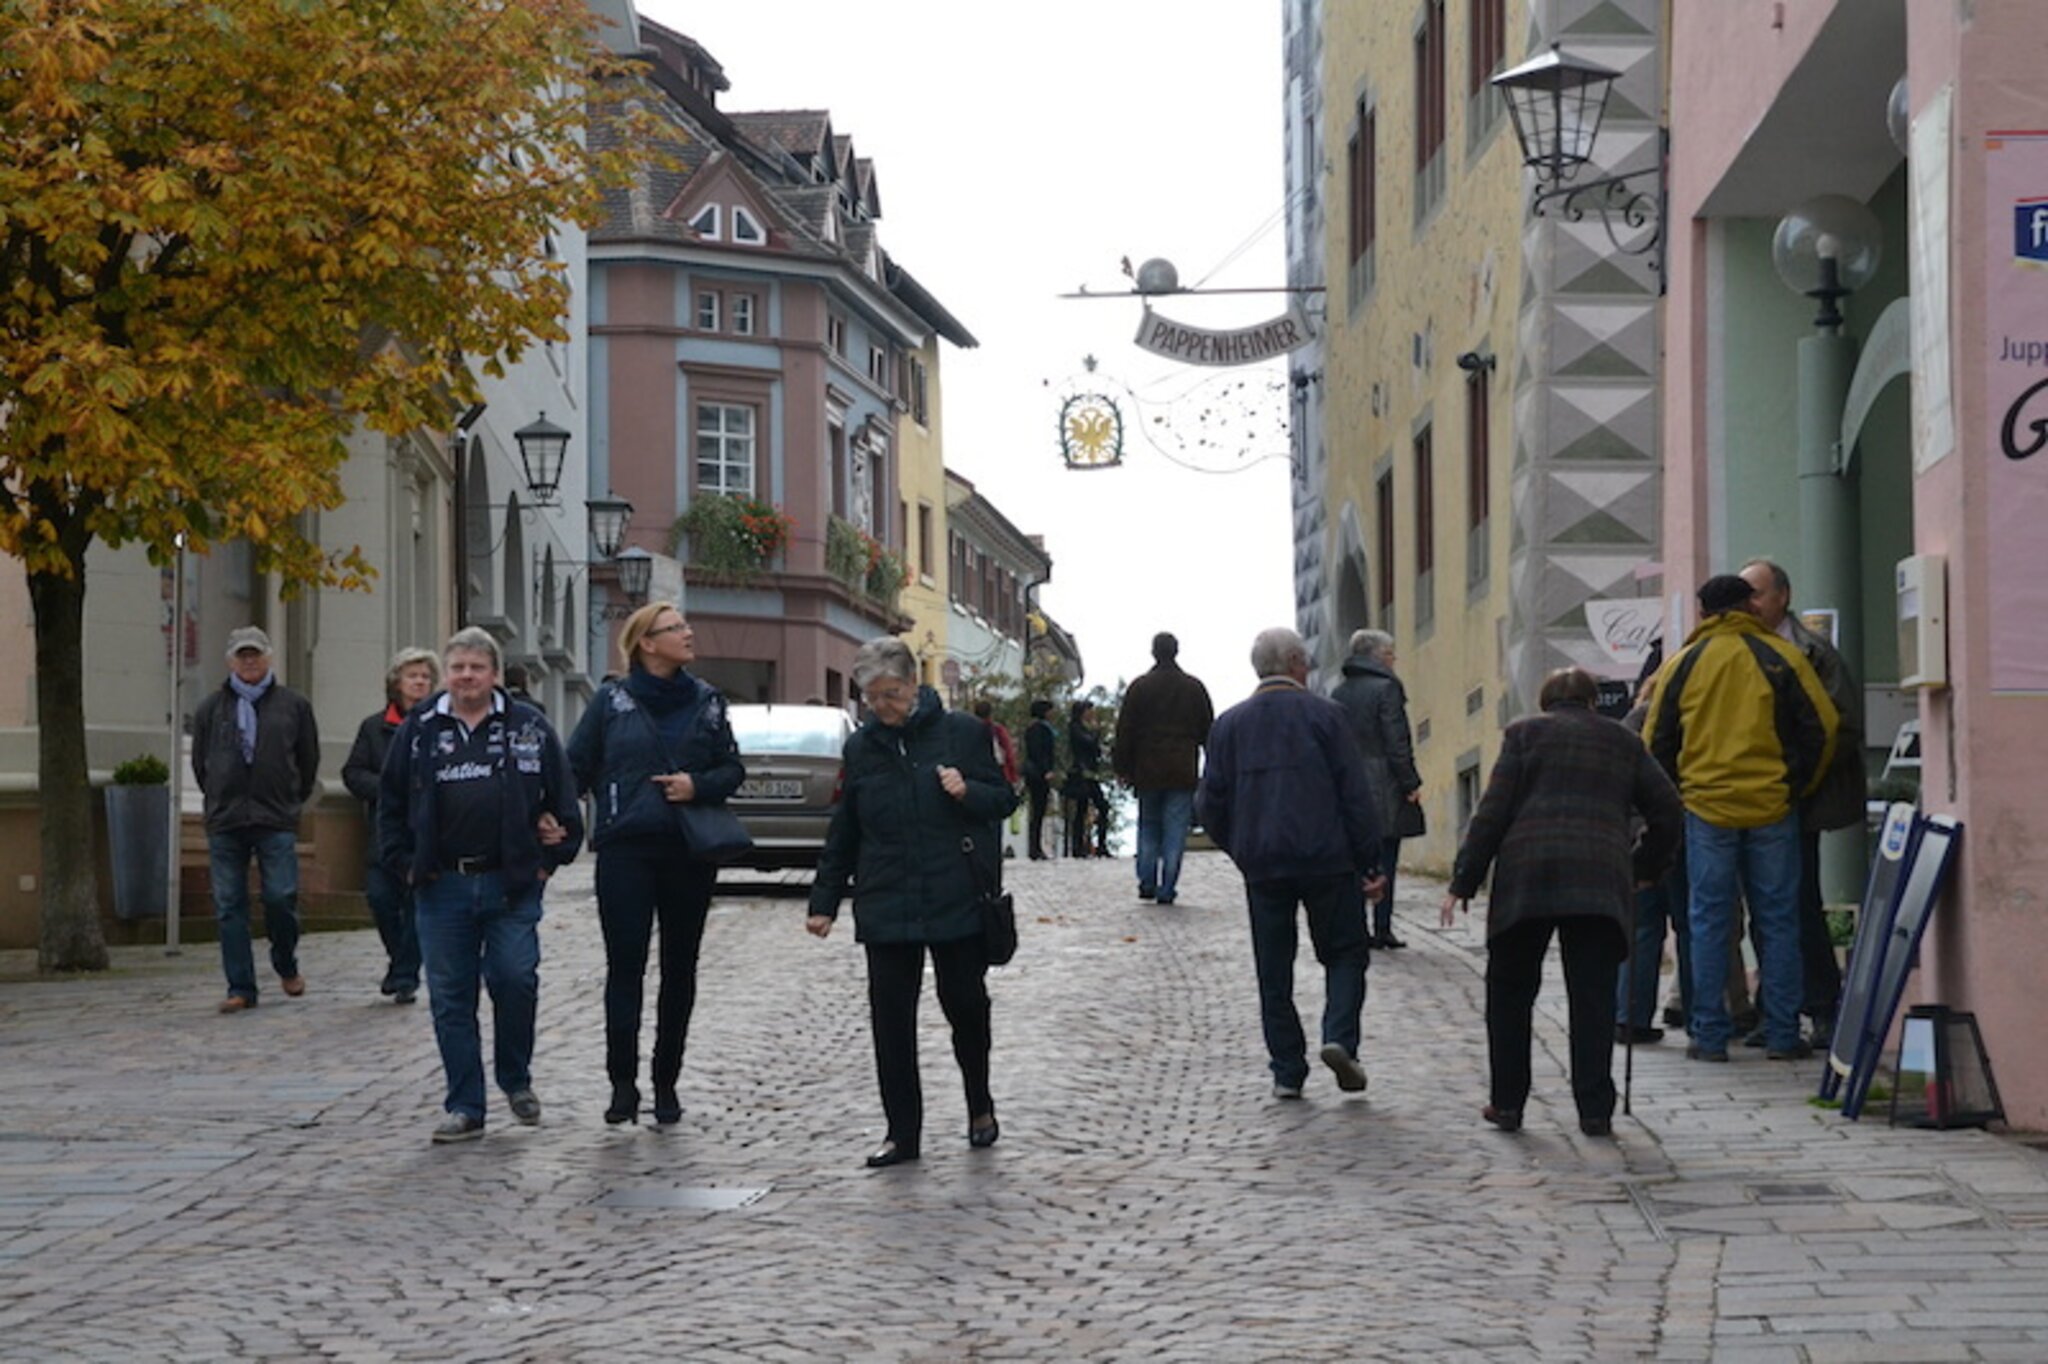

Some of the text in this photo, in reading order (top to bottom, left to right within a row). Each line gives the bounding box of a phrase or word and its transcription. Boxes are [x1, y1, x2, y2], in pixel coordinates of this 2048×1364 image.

[1150, 319, 1301, 362] PAPPENHEIMER
[2000, 335, 2048, 367] Jup
[1602, 607, 1663, 655] Caf
